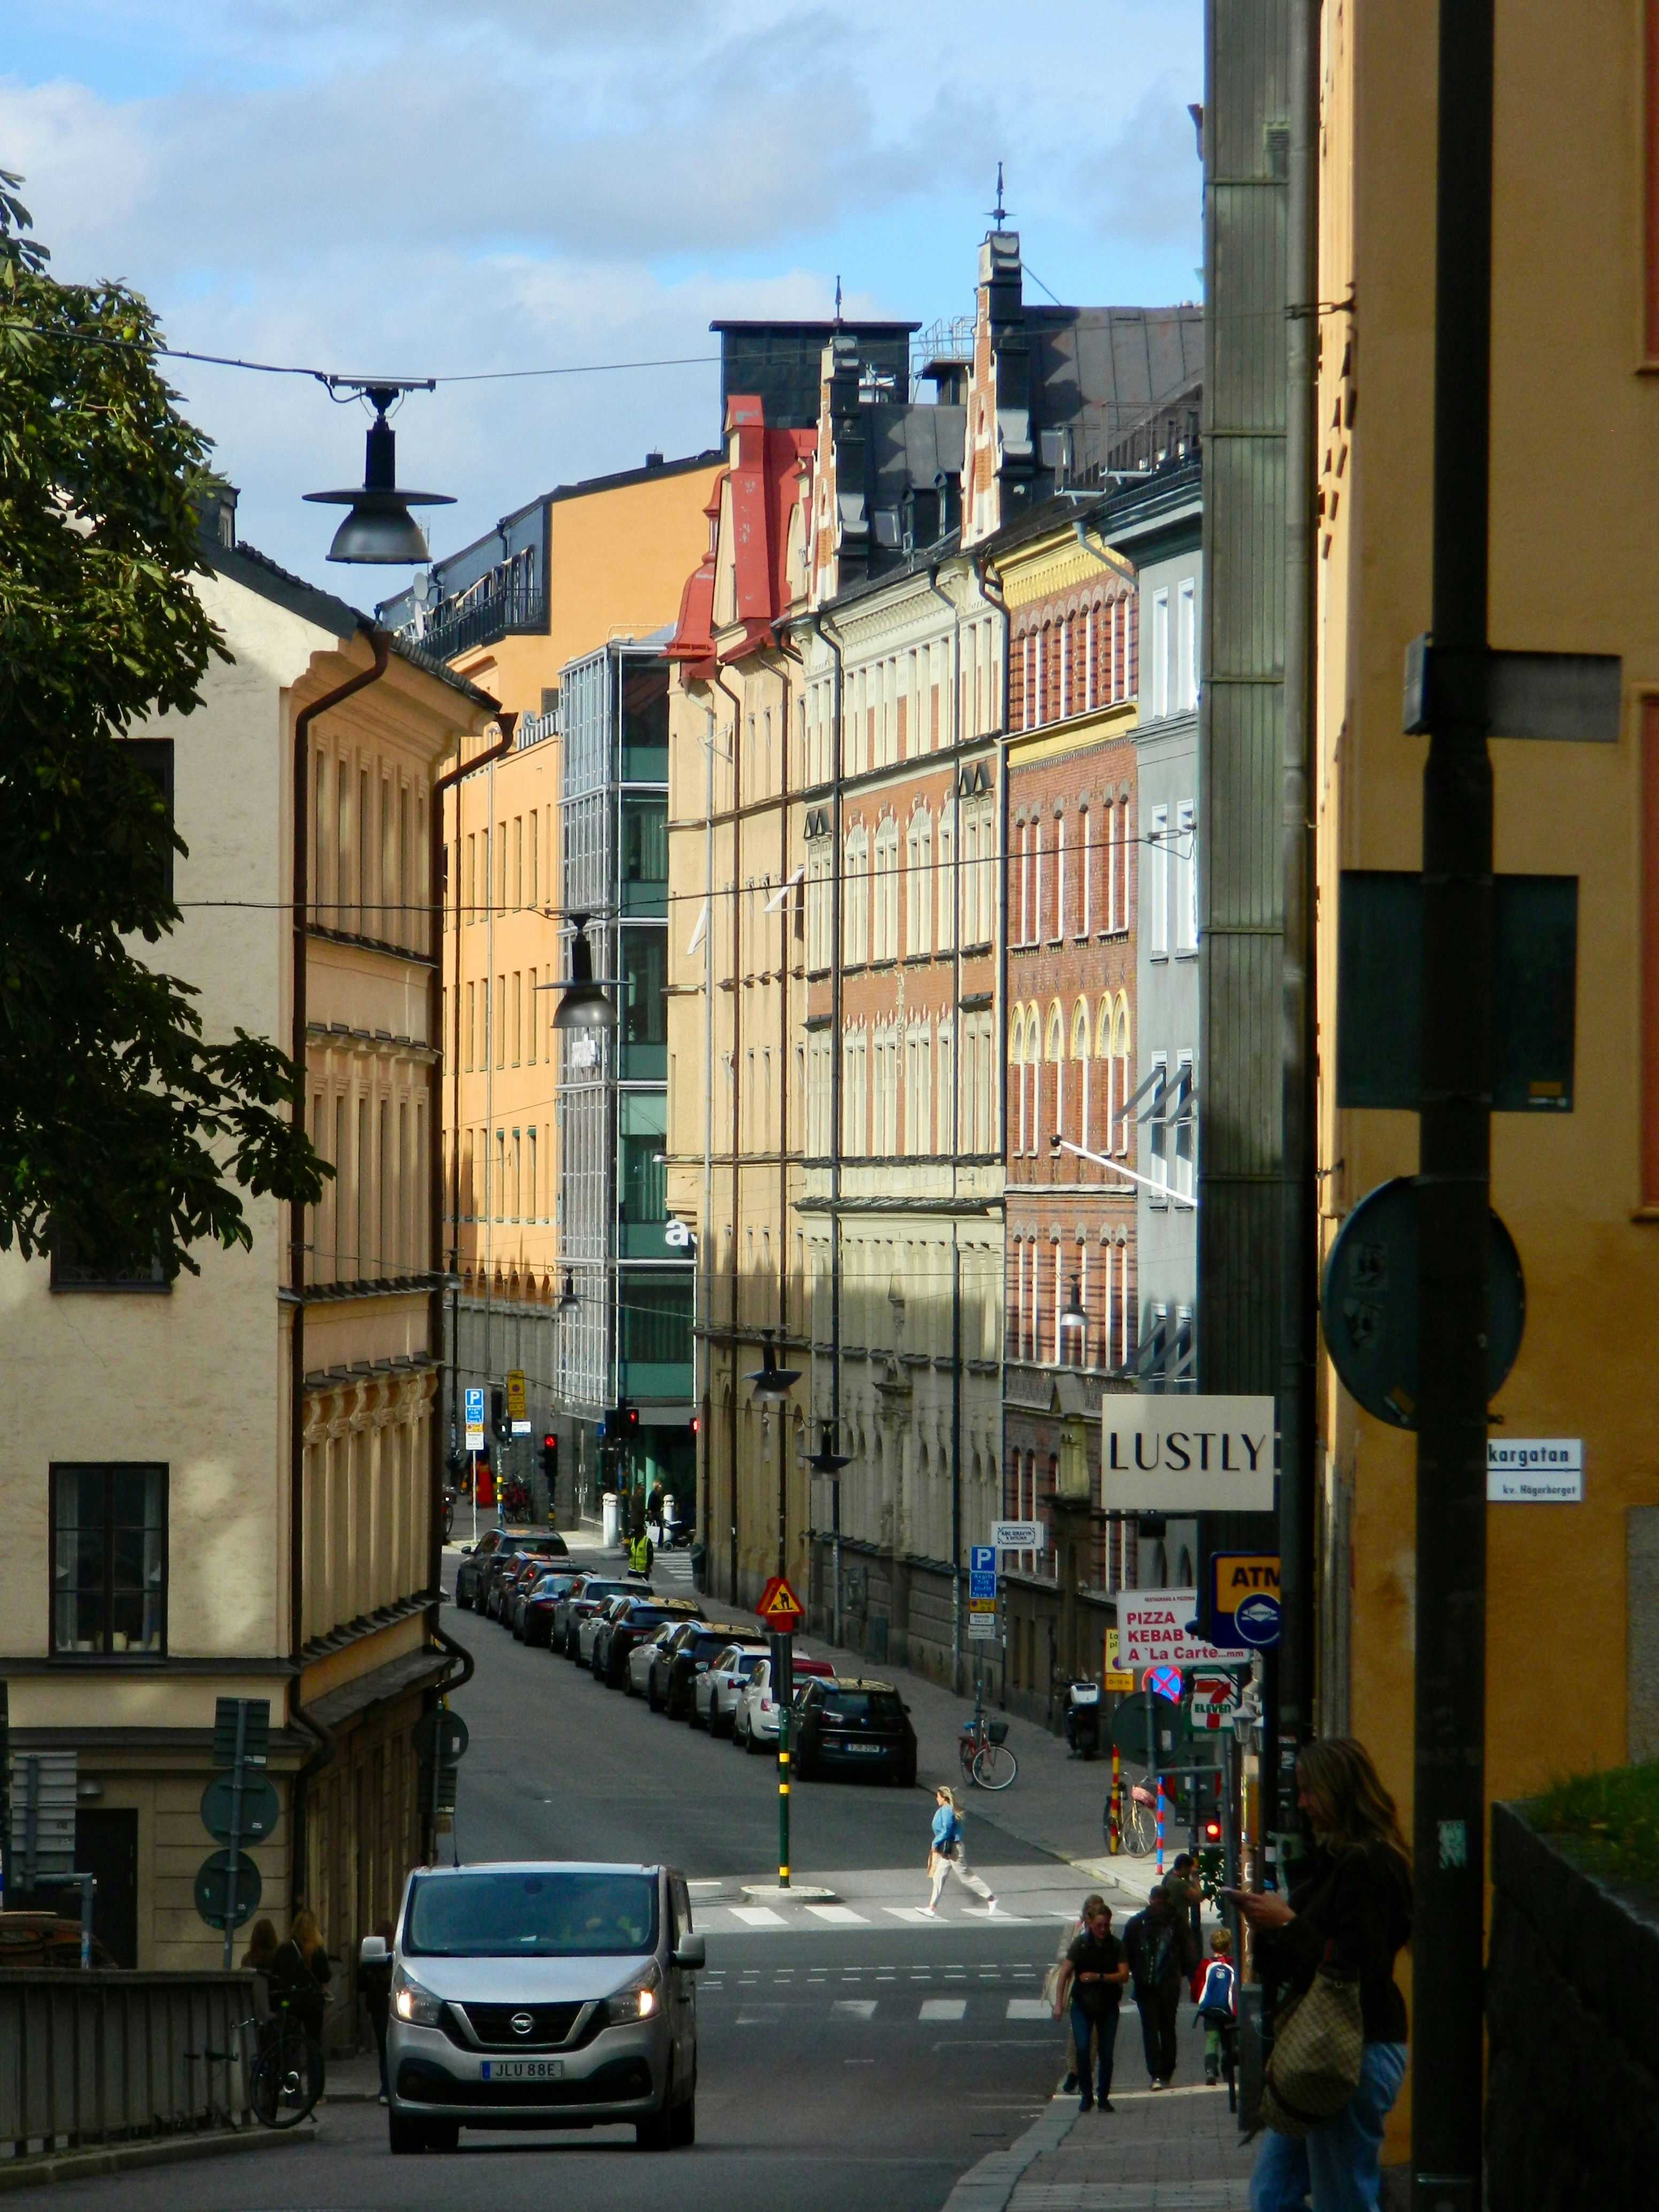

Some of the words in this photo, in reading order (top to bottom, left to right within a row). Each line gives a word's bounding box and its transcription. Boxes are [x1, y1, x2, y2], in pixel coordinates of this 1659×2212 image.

[665, 1219, 697, 1246] a
[470, 1391, 480, 1405] P
[1111, 1432, 1265, 1470] LUSTLY
[977, 1548, 992, 1569] P
[1127, 1612, 1176, 1625] PIZZA
[1128, 1629, 1184, 1643] KEBAB
[1128, 1648, 1140, 1661] A
[496, 2063, 523, 2077] JLU
[527, 2063, 555, 2077] 88E
